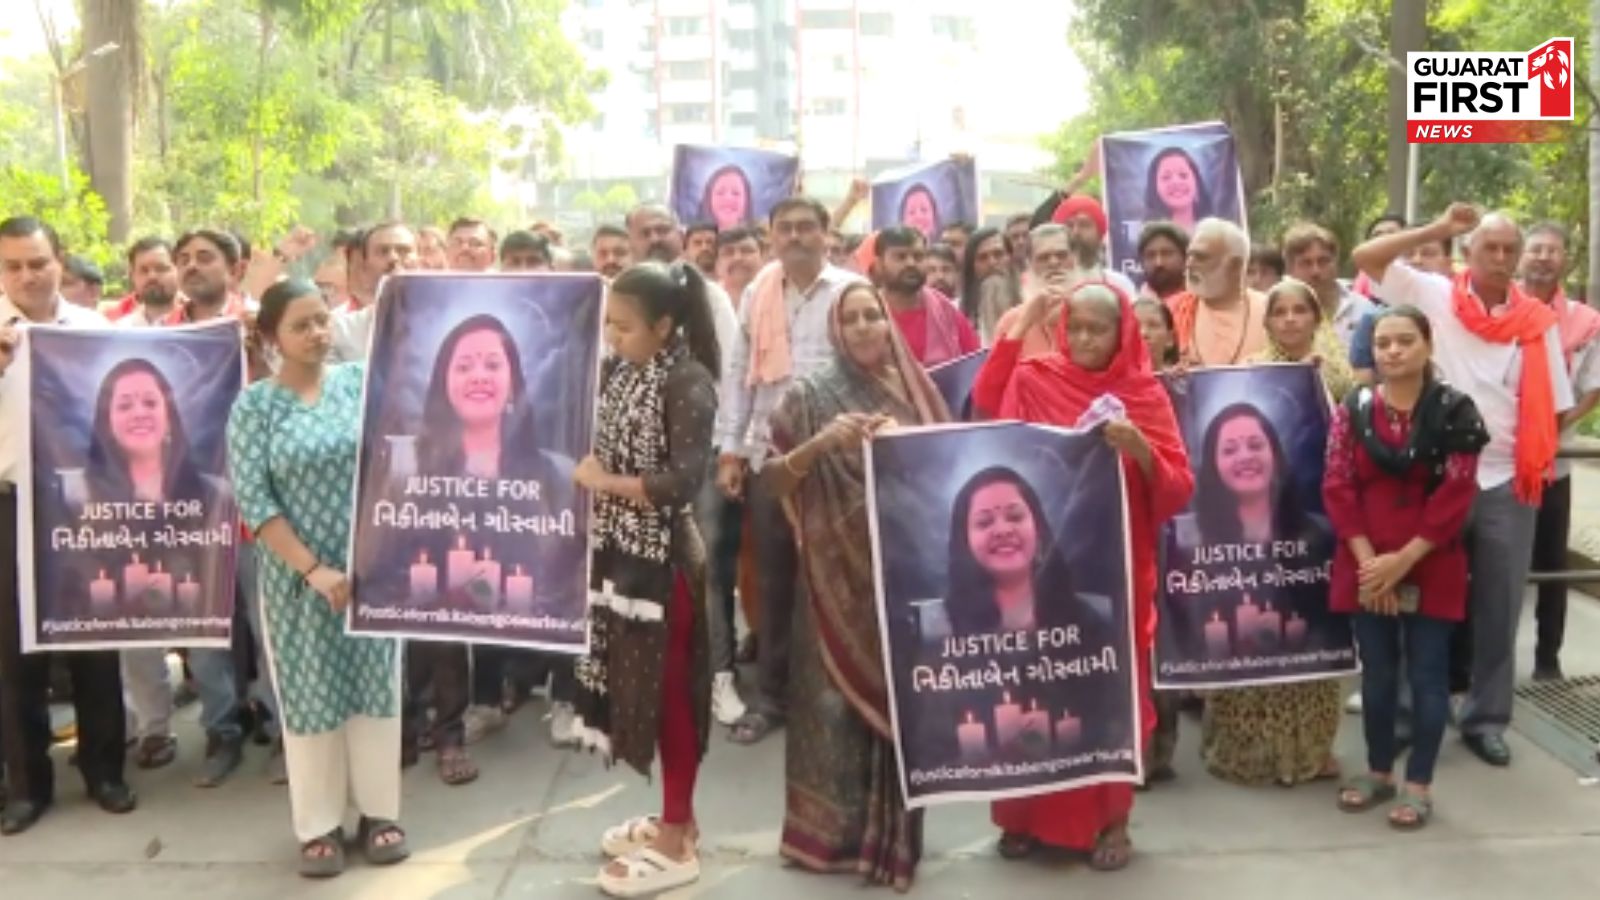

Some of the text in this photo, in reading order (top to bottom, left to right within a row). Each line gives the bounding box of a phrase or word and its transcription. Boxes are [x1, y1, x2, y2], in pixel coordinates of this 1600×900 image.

[404, 476, 540, 500] JUSTICE FOR
[80, 500, 203, 520] JUSTICE FOR
[1191, 540, 1308, 565] JUSTICE FOR
[942, 624, 1081, 658] JUSTICE FOR
